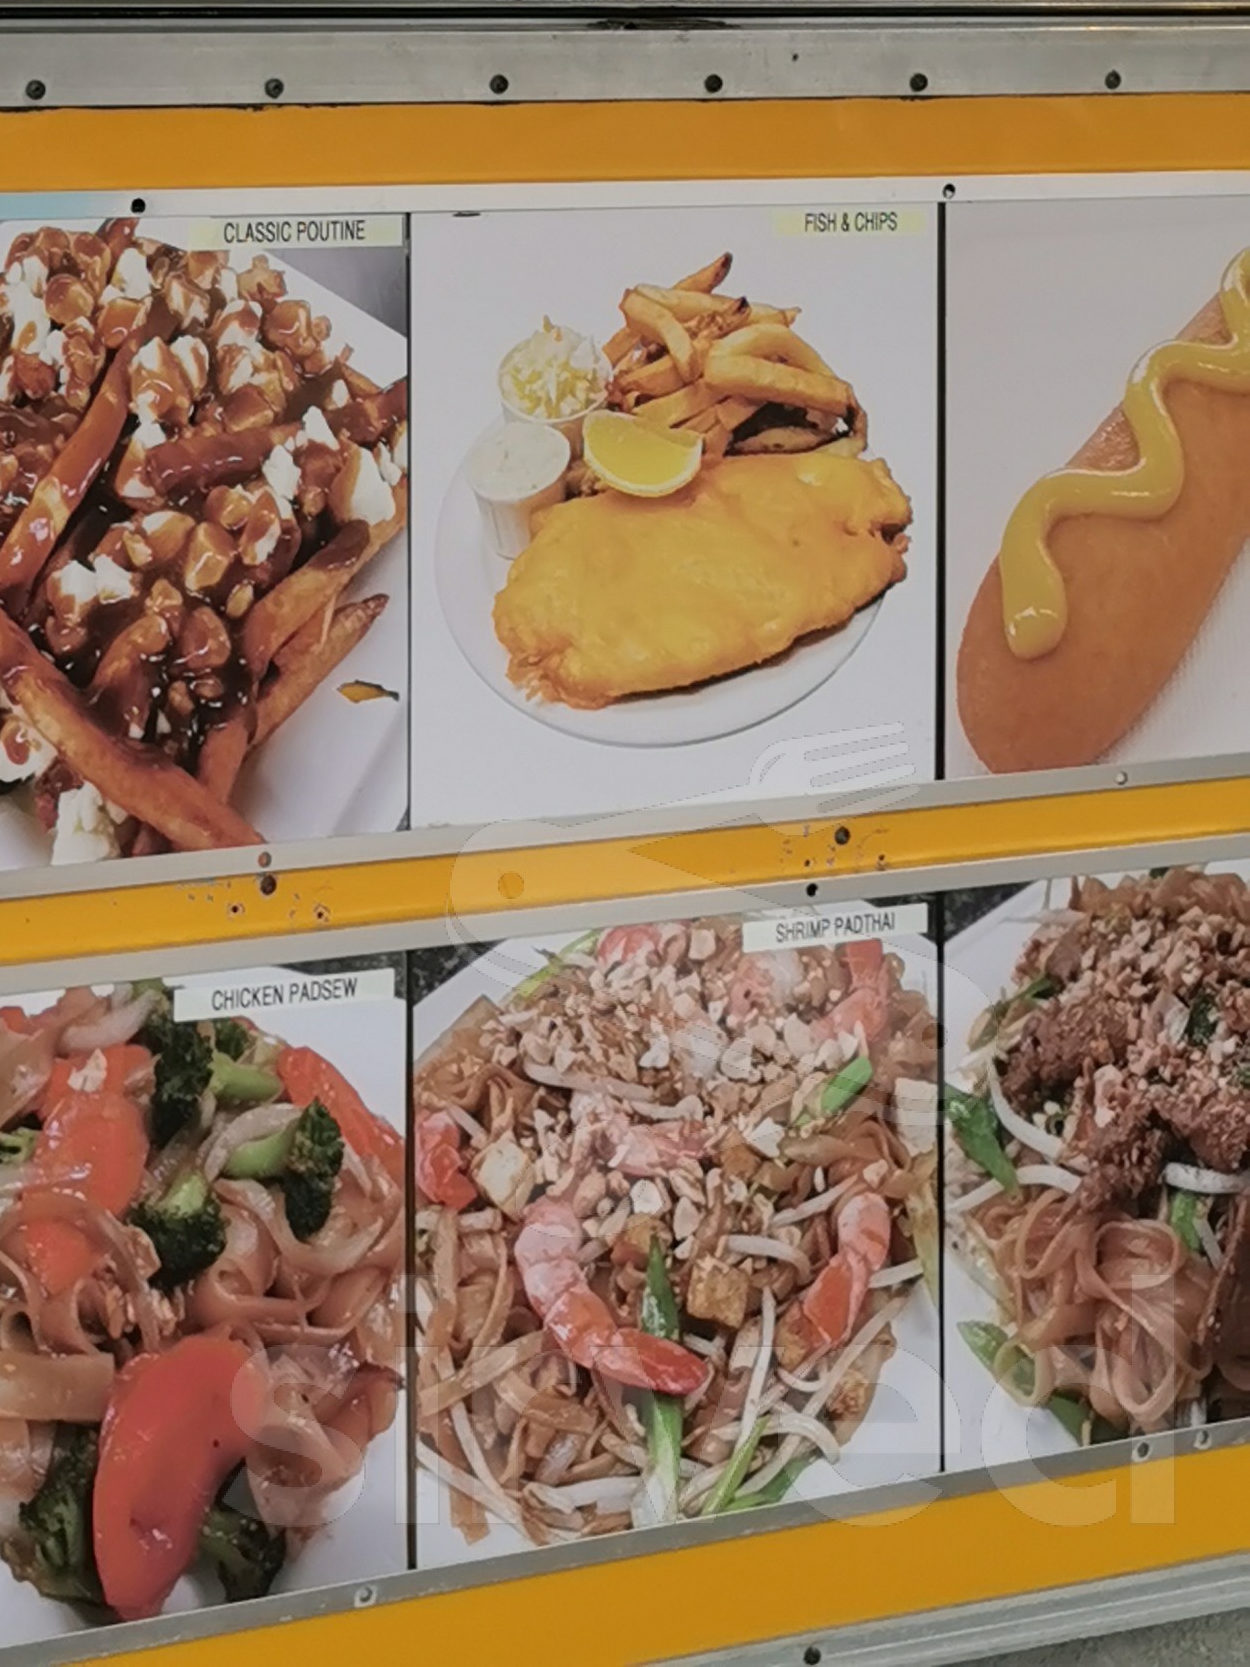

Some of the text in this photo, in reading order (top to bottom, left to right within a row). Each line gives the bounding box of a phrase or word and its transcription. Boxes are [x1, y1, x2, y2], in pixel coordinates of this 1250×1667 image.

[223, 219, 366, 243] CLASSIC POUTINE
[804, 211, 898, 232] FISH & CHIPS
[776, 912, 896, 943] SHRIMP PADTHAI
[211, 978, 358, 1011] CHICKEN PADSEW
